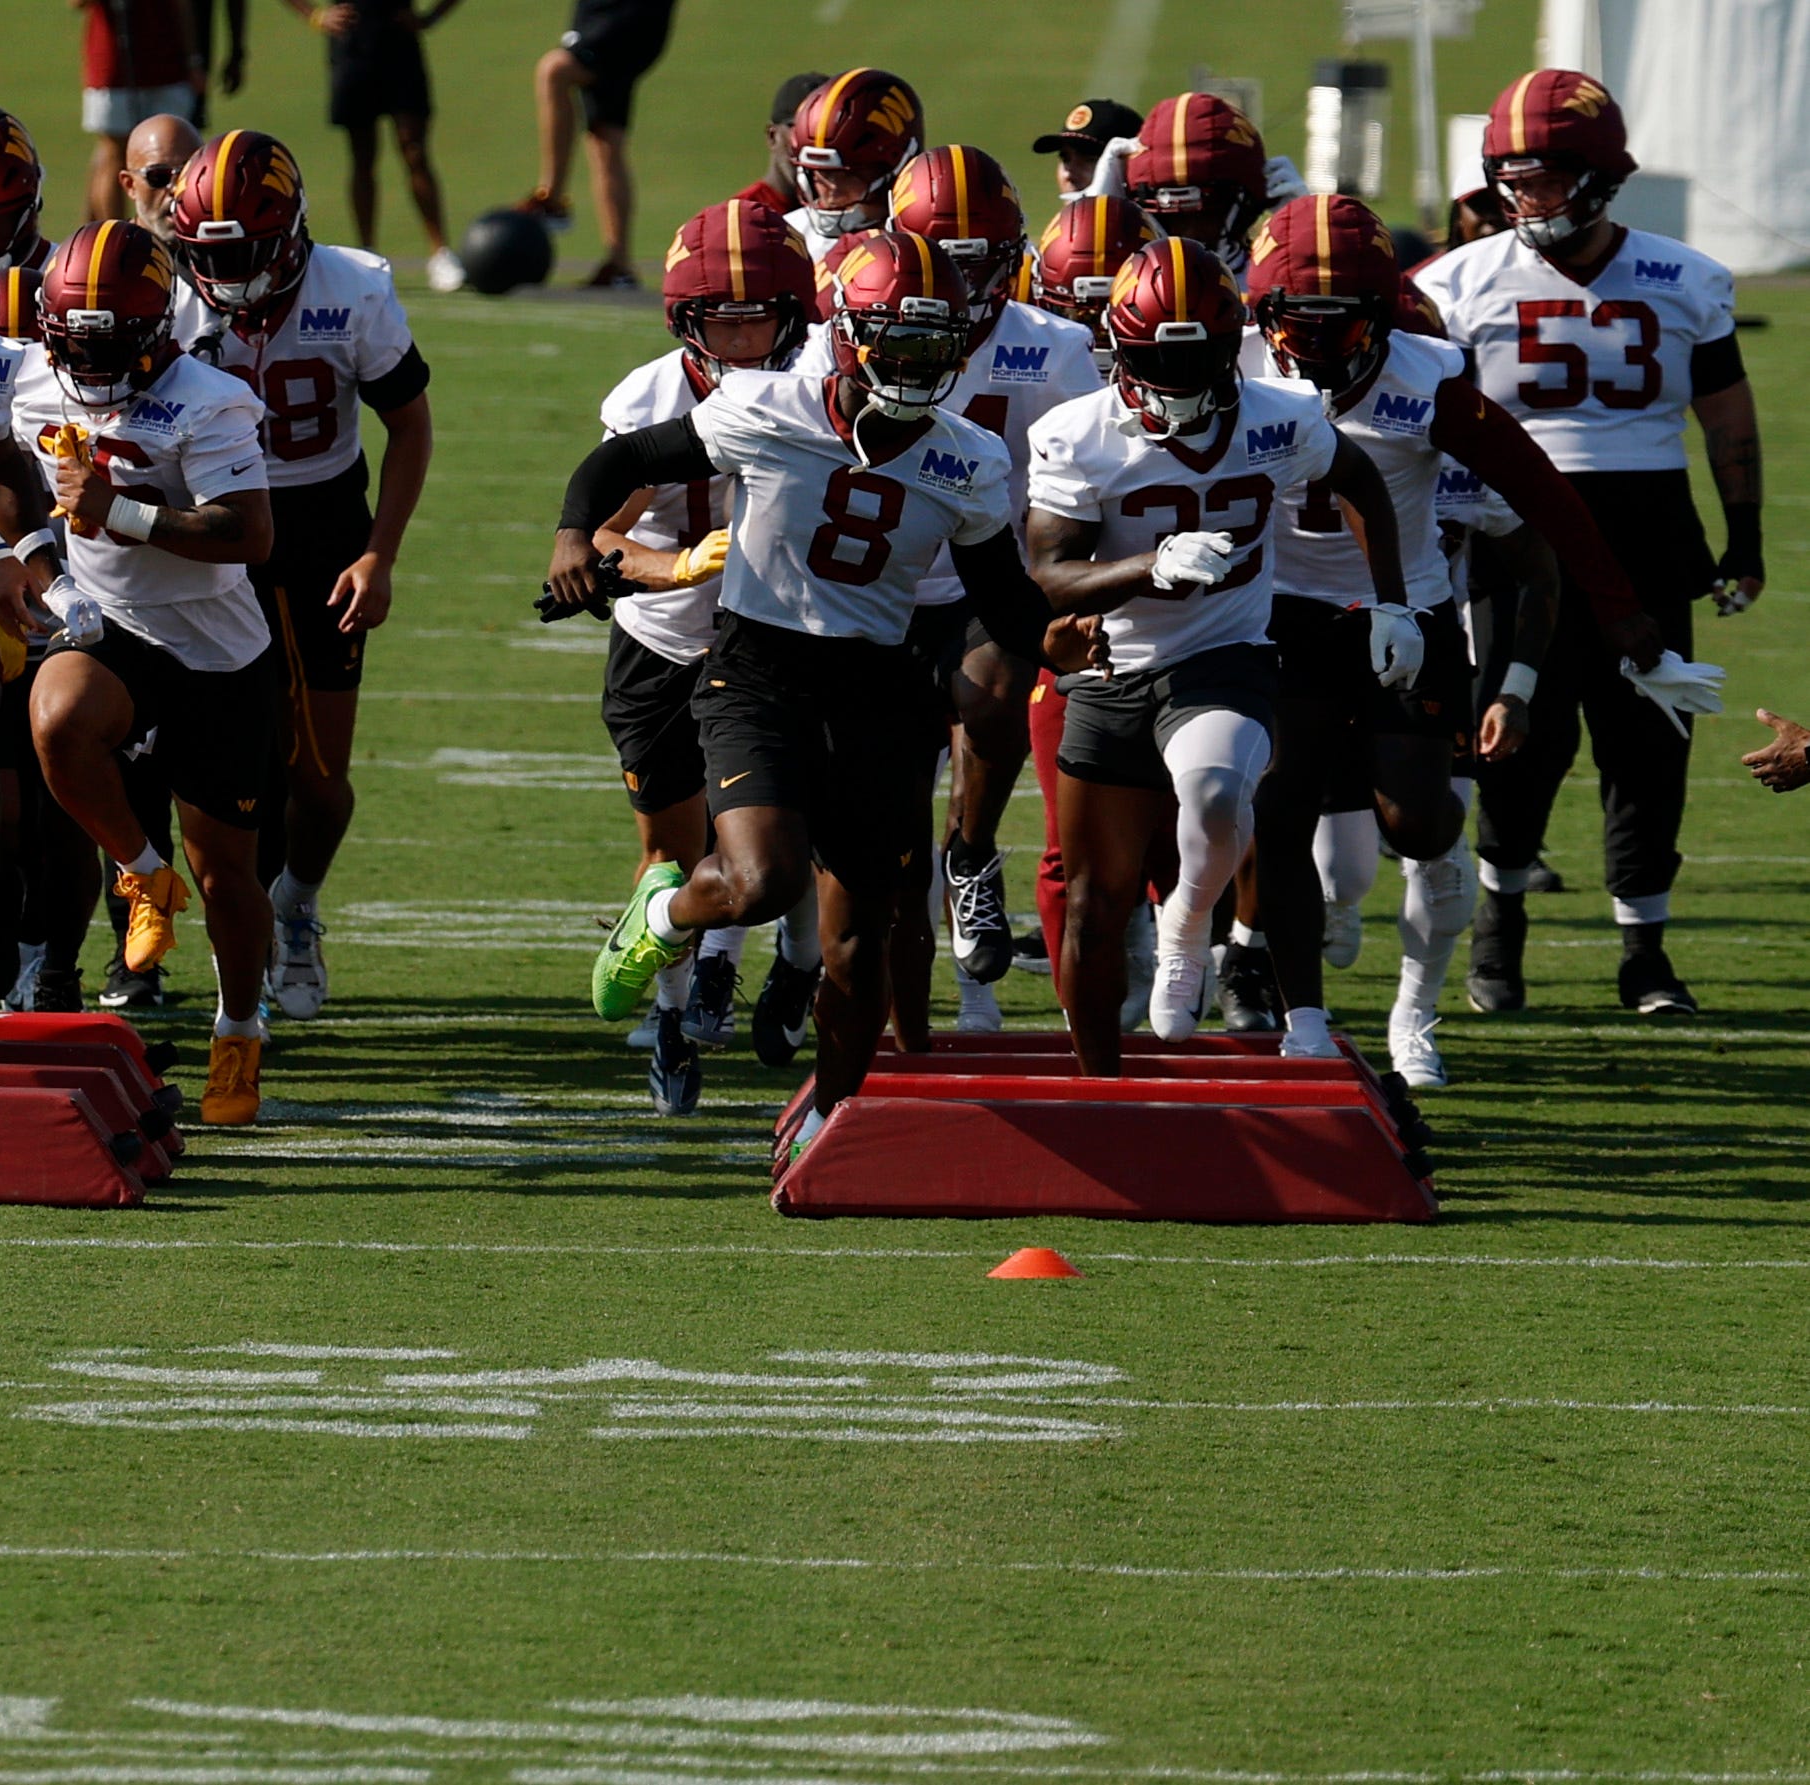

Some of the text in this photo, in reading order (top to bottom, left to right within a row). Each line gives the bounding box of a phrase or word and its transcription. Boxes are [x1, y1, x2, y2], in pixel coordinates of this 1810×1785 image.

[1635, 258, 1683, 282] NW
[300, 309, 351, 331] NW
[993, 345, 1050, 370] NW
[1517, 299, 1662, 410] 53
[992, 370, 1049, 379] NORTHWEST
[223, 358, 337, 462] 8
[1373, 393, 1430, 423] NW
[129, 417, 176, 431] NORTHWEST
[1371, 417, 1427, 432] NORTHWEST
[1248, 421, 1297, 455] NW
[1248, 444, 1298, 462] NORTHWEST
[807, 464, 906, 586] 8
